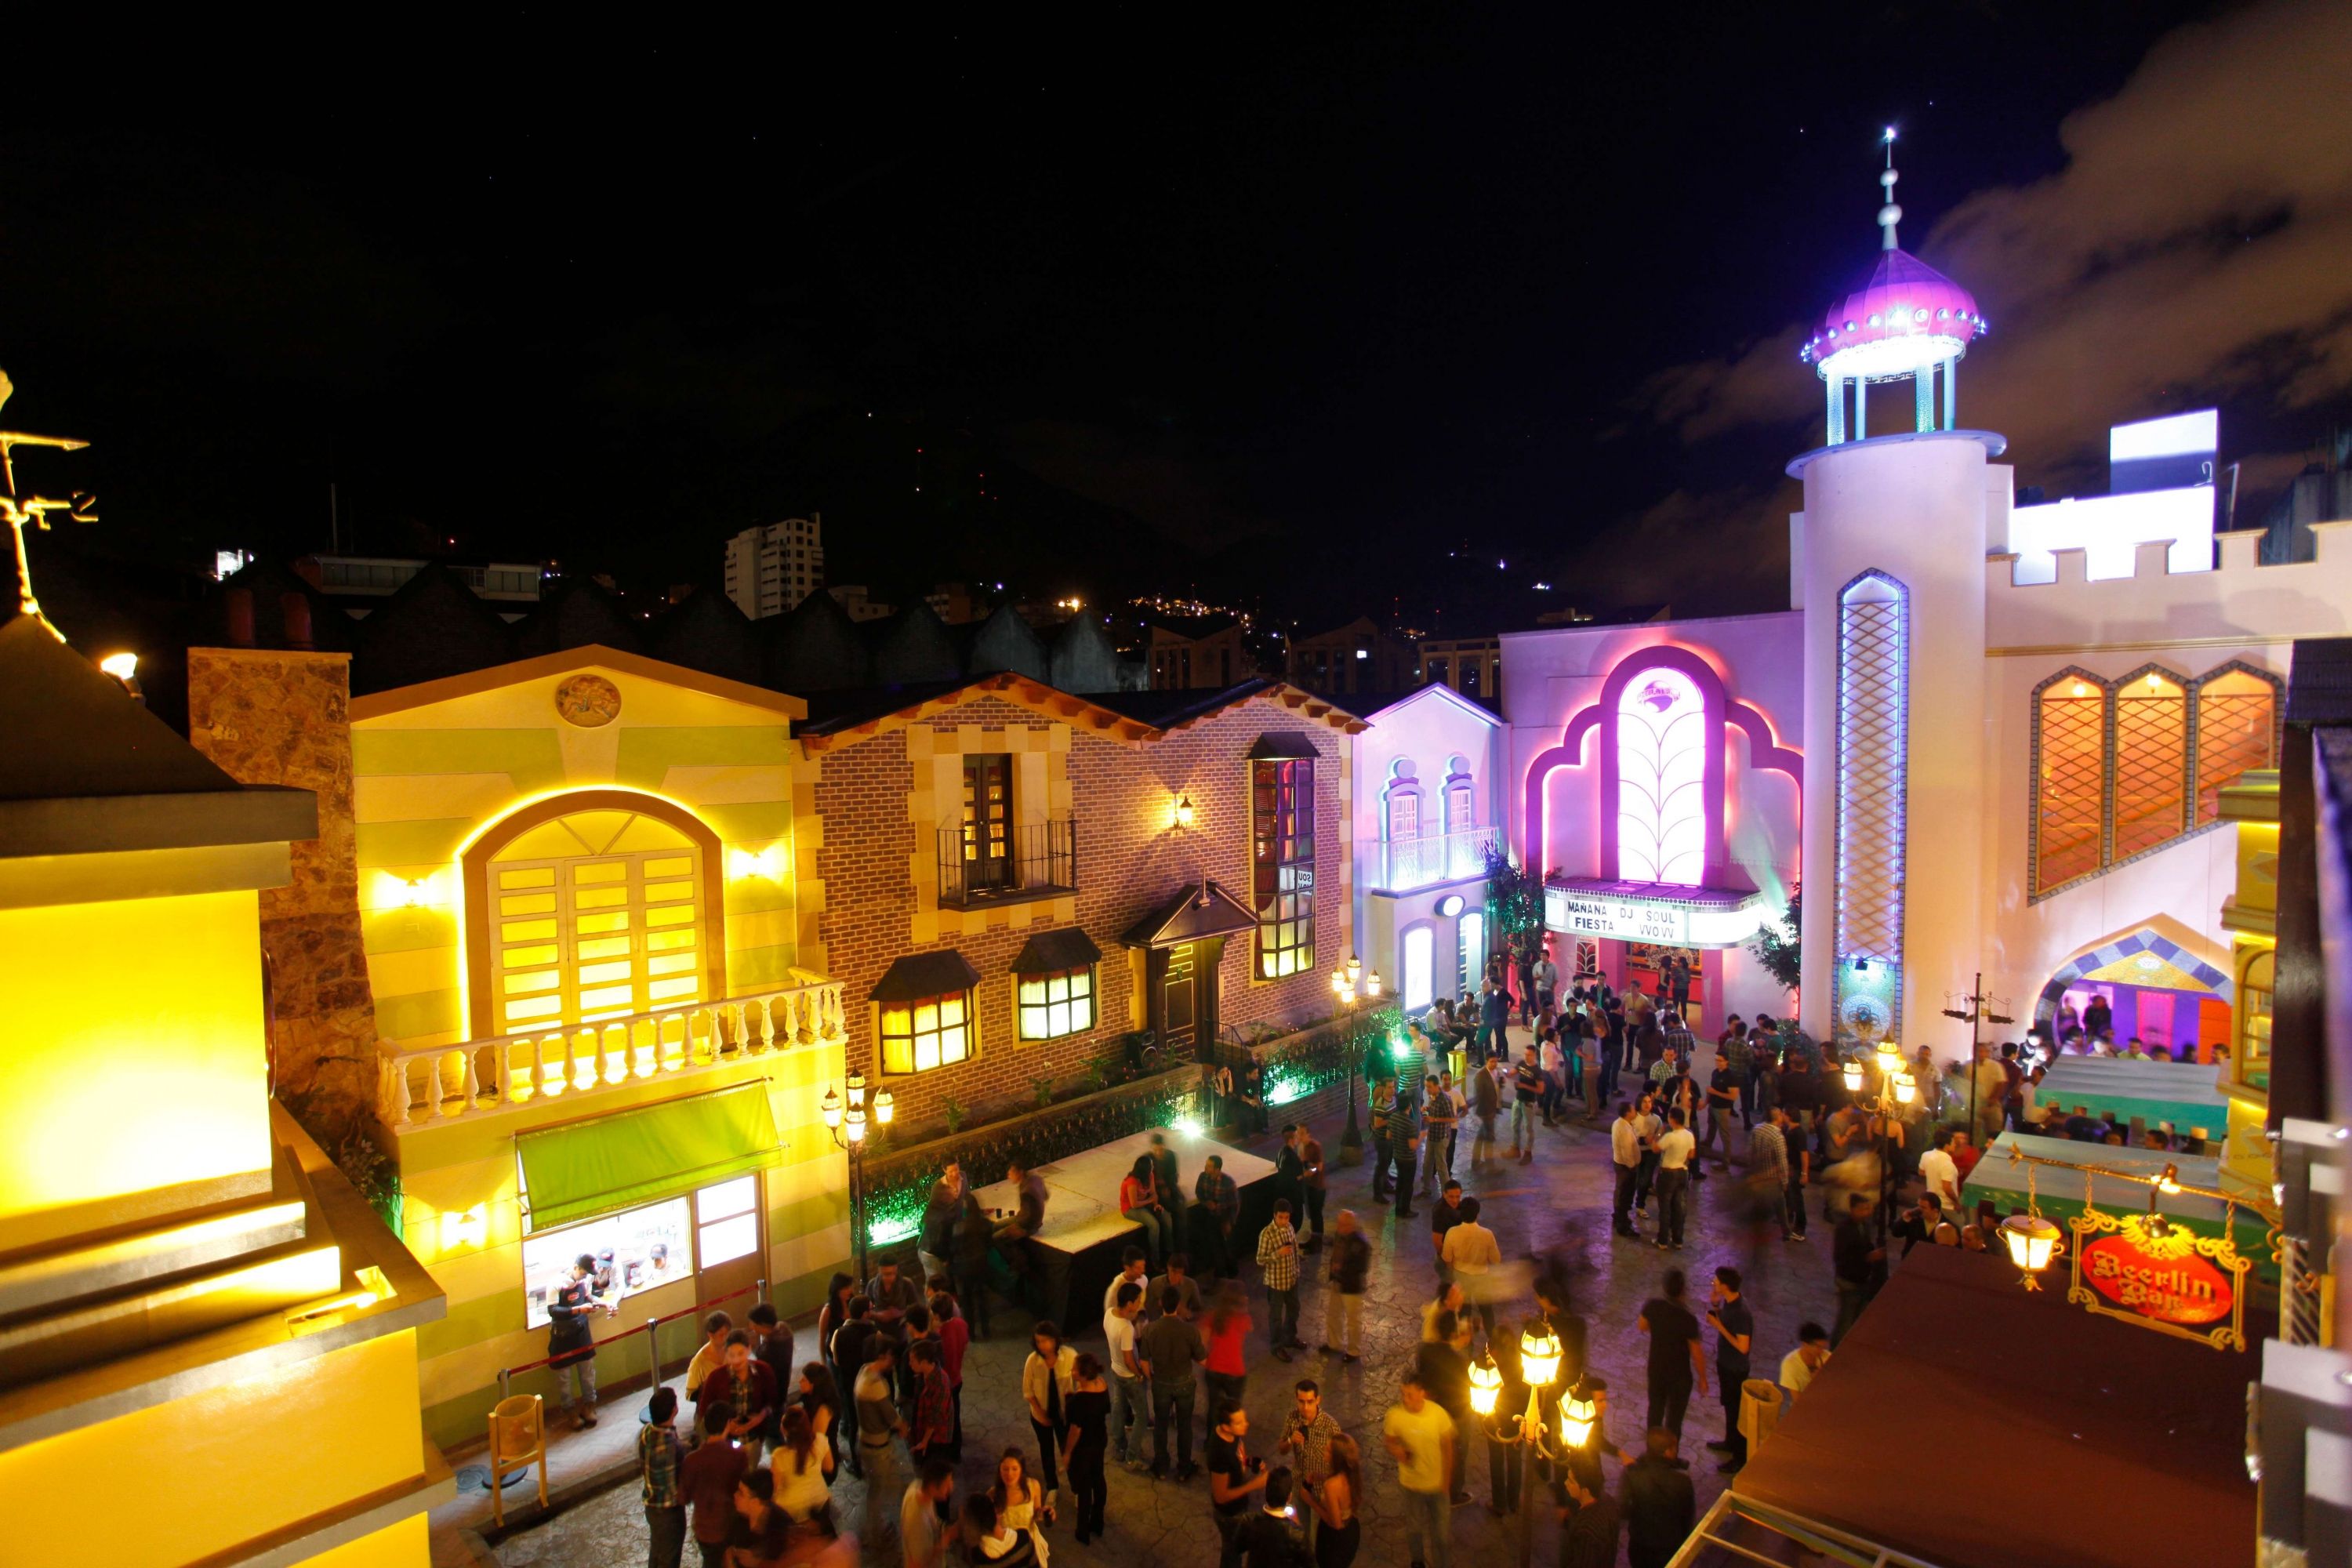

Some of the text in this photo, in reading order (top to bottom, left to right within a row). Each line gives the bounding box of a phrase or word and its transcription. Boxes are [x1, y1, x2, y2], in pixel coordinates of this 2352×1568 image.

[1568, 901, 1675, 924] MAÑANA DJ SOUL
[1575, 916, 1615, 931] FIESTA
[2093, 1250, 2212, 1300] Beerlin
[2119, 1278, 2183, 1309] Bar
